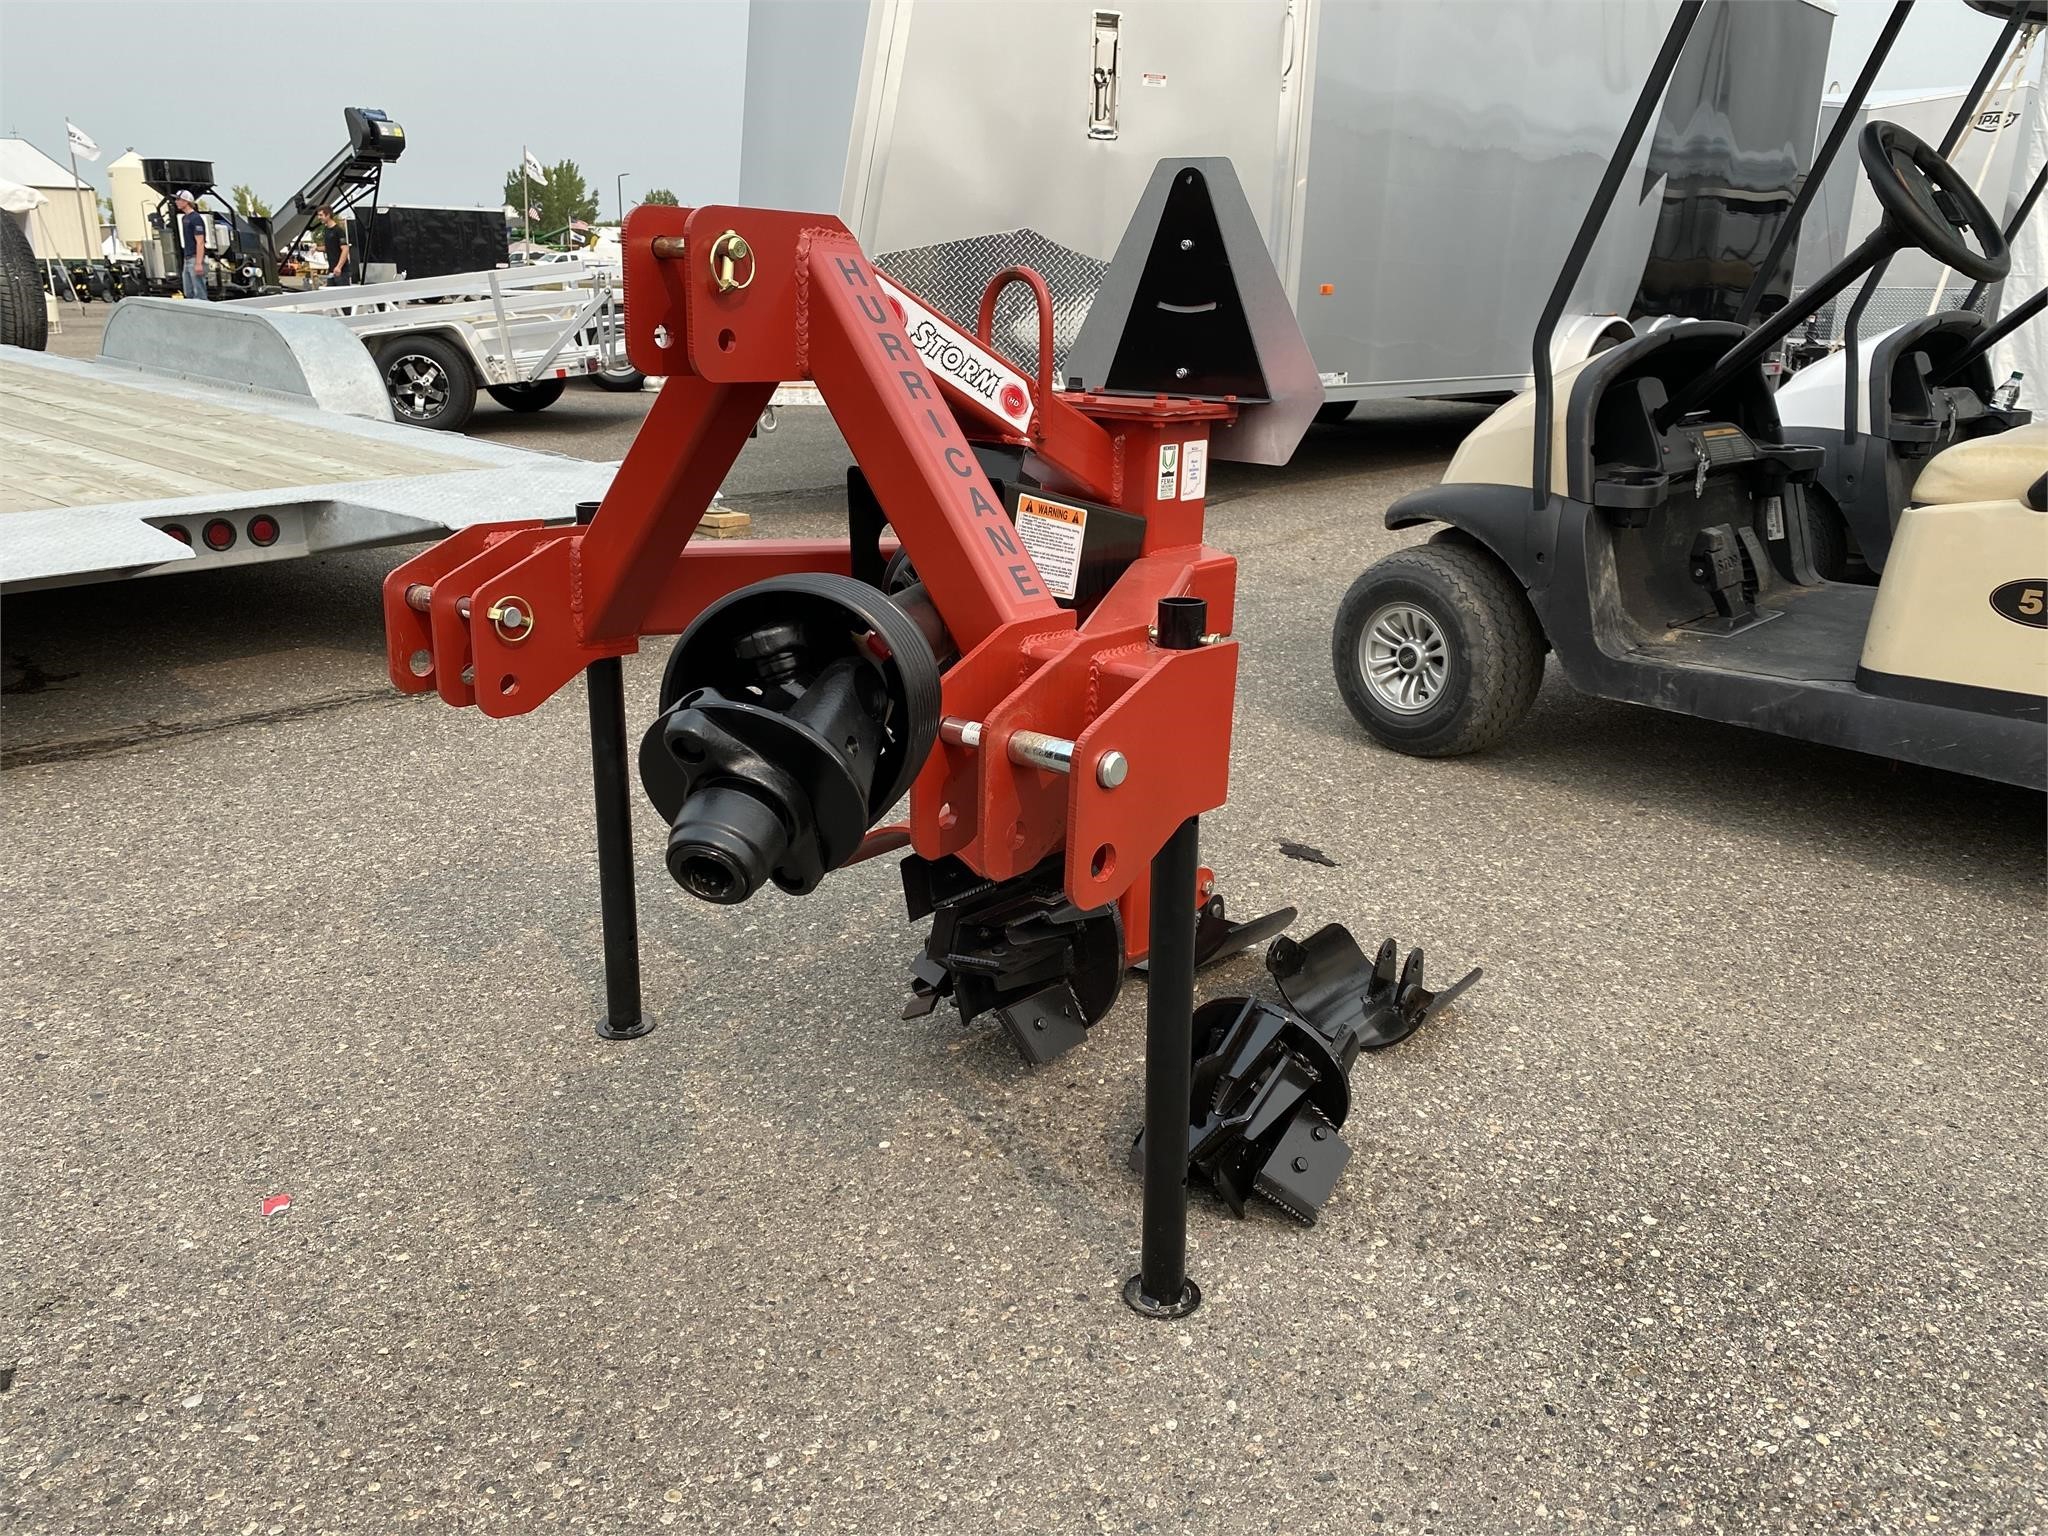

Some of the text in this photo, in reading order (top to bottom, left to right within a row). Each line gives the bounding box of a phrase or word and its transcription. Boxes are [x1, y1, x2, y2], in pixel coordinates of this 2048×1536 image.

[910, 319, 1003, 400] STORM
[1008, 395, 1021, 407] HD
[835, 257, 1040, 596] HURRICANE
[1038, 503, 1069, 521] WARNING
[2018, 589, 2044, 615] 5
